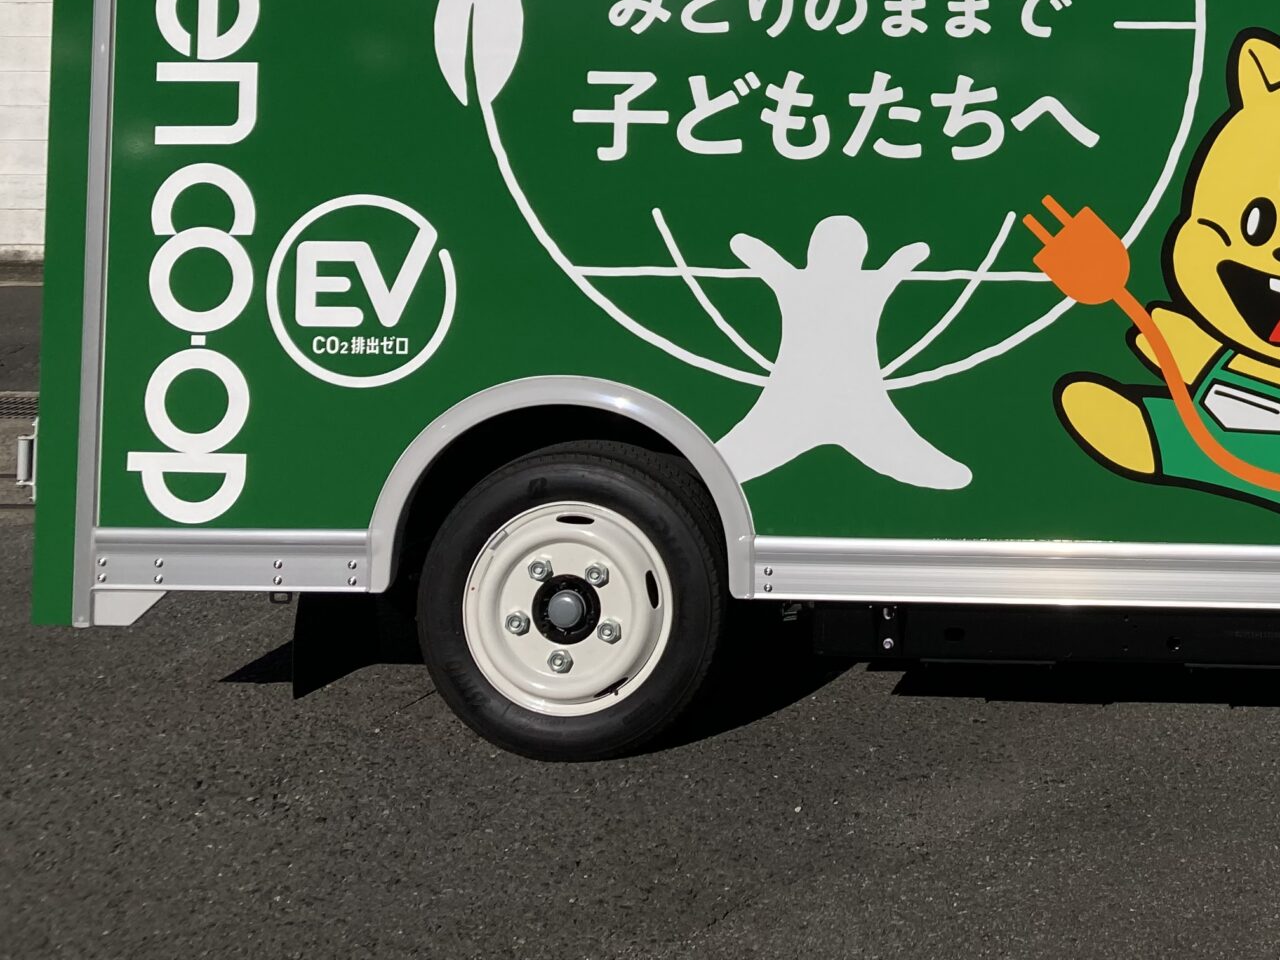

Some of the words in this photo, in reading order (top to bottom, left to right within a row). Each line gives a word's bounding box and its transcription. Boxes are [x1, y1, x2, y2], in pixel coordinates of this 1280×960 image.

[572, 70, 1100, 161] 子どもたちへ
[295, 227, 438, 328] EV
